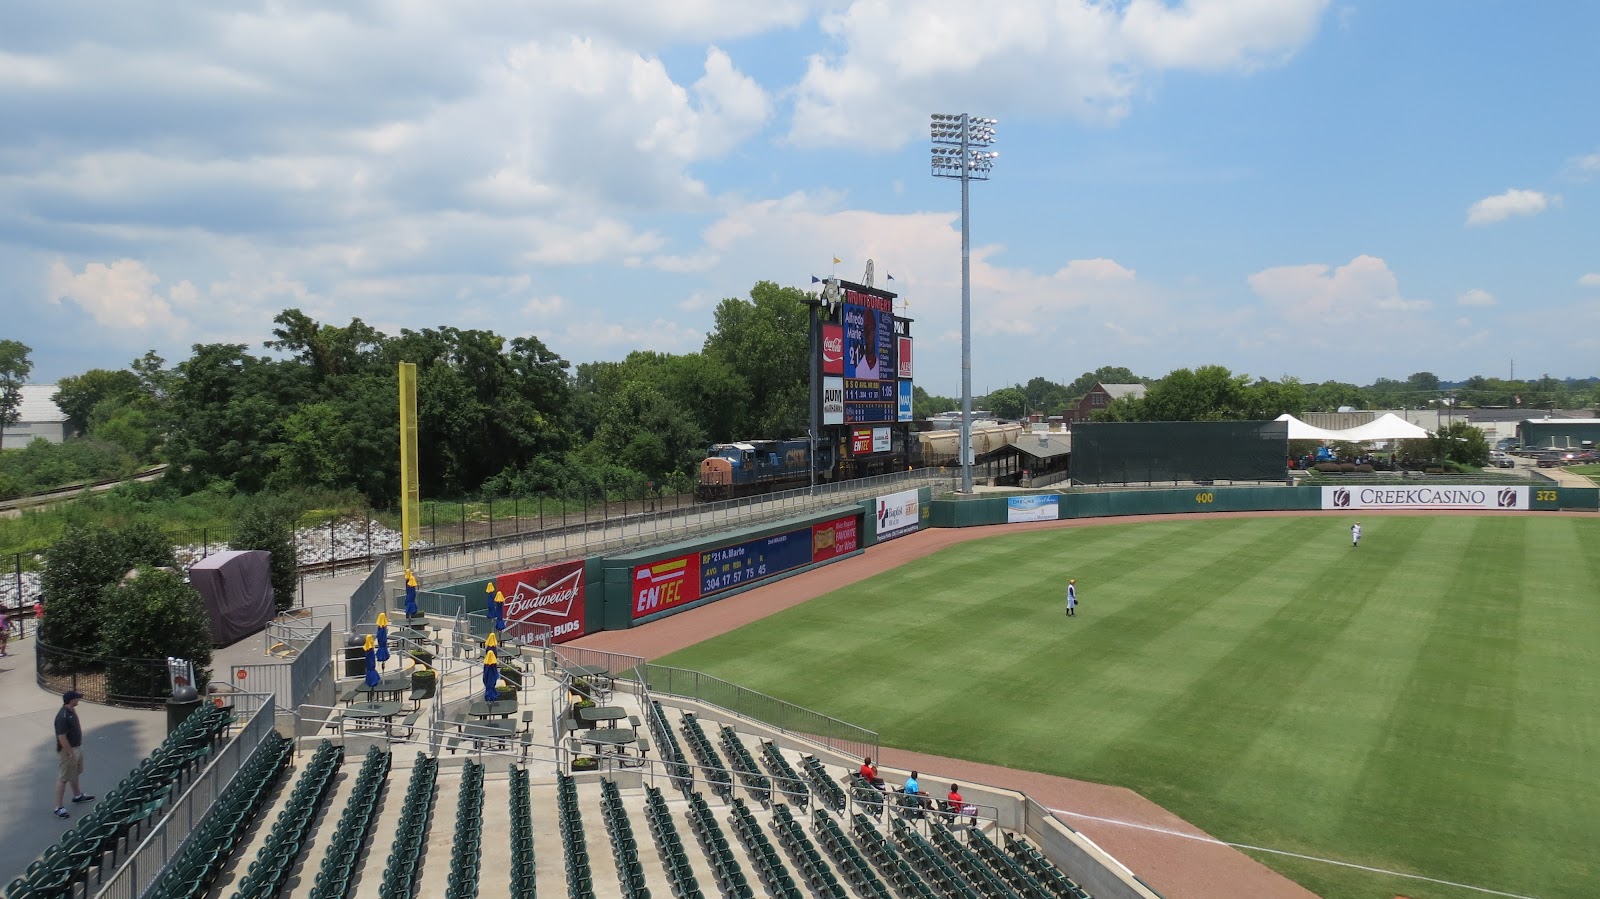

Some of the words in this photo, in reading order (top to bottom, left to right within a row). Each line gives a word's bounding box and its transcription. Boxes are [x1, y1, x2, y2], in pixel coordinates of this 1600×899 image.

[848, 290, 891, 311] MONTGOMERY
[845, 311, 864, 325] Alfredo
[849, 346, 859, 365] 21
[825, 390, 841, 403] AUM
[854, 440, 869, 451] ENTEC
[1196, 493, 1212, 503] 400
[1537, 490, 1557, 501] 373
[889, 506, 903, 519] Baptist
[836, 527, 856, 541] FAVORITE
[836, 543, 844, 553] Car
[844, 539, 856, 551] Wash
[702, 553, 711, 565] RF
[722, 563, 730, 572] HR
[733, 560, 742, 569] RBI
[747, 557, 752, 565] H
[759, 554, 764, 562] R
[704, 577, 721, 592] .304
[722, 573, 731, 585] 17
[733, 570, 742, 583] 57
[746, 567, 754, 579] 75
[758, 564, 766, 575] 45
[637, 579, 684, 612] ENTEC
[504, 588, 579, 619] Budweiser
[554, 620, 580, 637] BUDS
